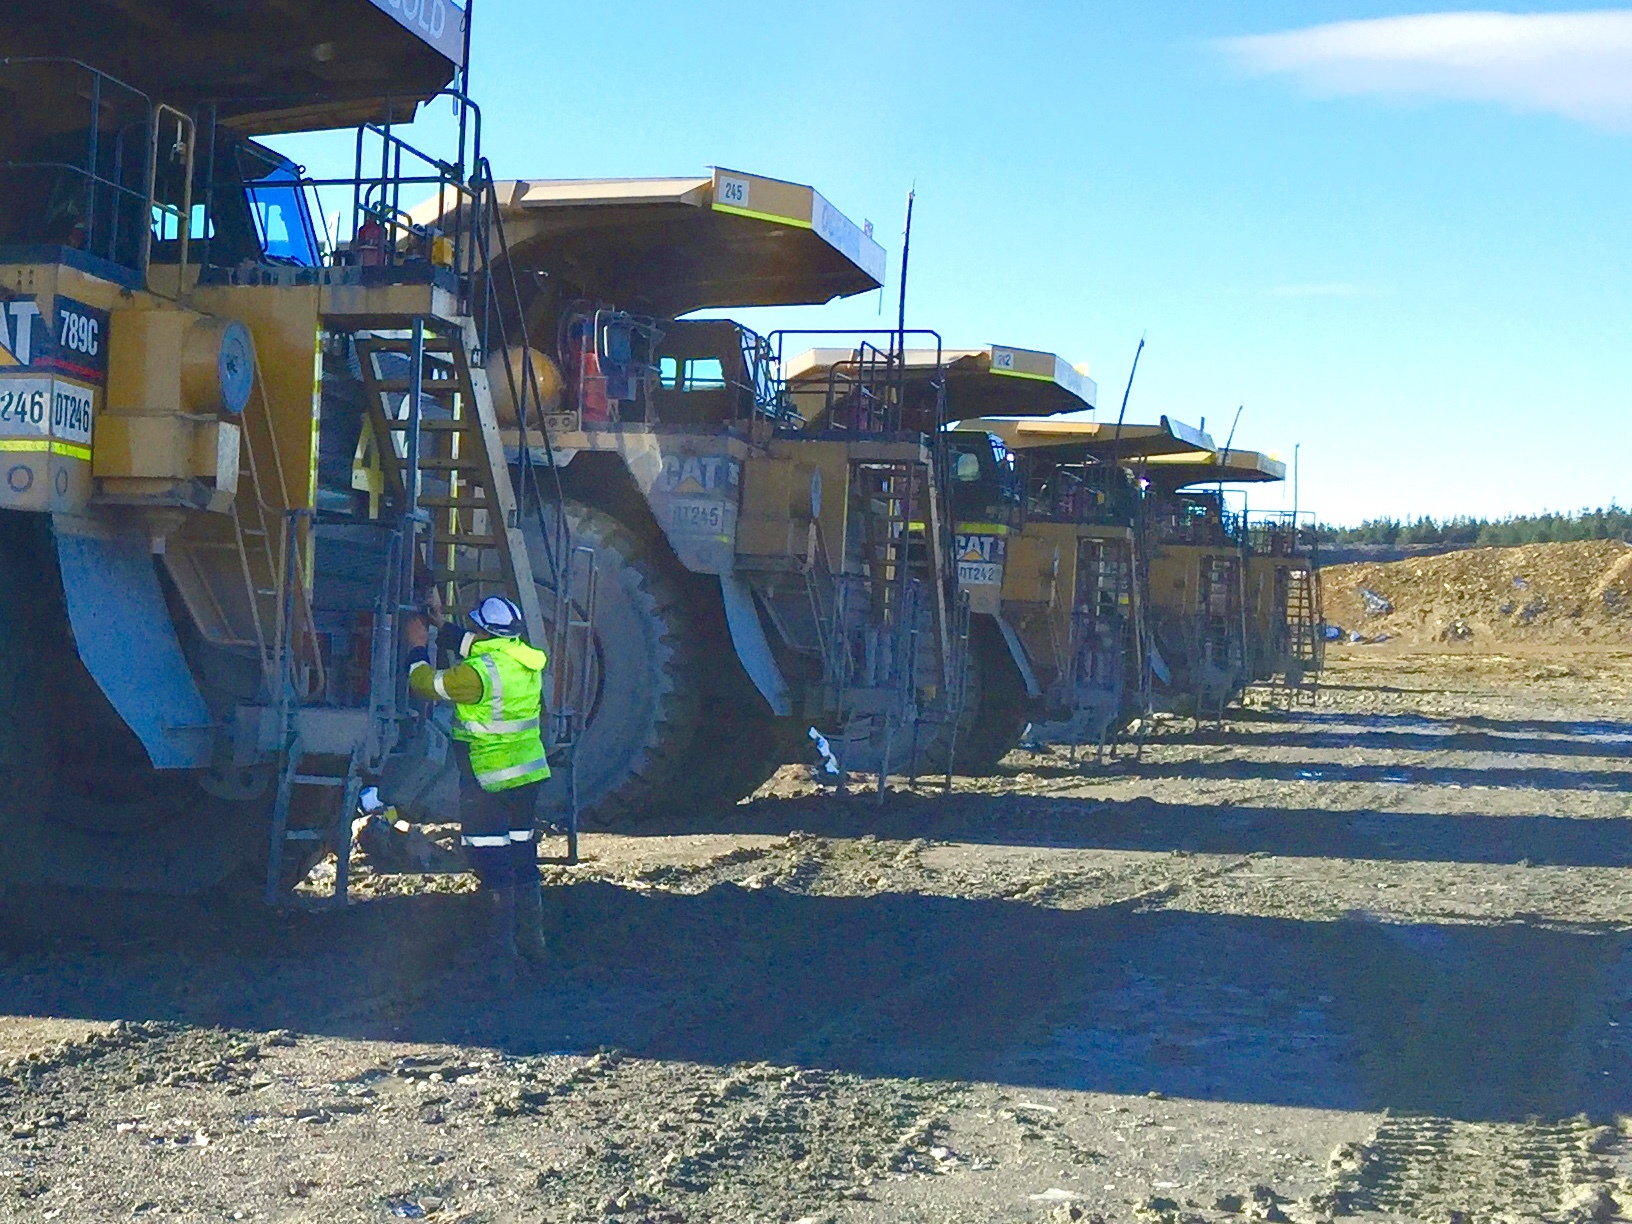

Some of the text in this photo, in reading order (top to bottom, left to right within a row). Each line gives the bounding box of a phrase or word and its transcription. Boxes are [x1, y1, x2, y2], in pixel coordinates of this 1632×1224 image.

[725, 182, 743, 201] 245
[60, 309, 99, 356] 789C
[55, 391, 90, 433] DT246
[659, 455, 721, 492] CAT
[955, 535, 995, 561] CAT
